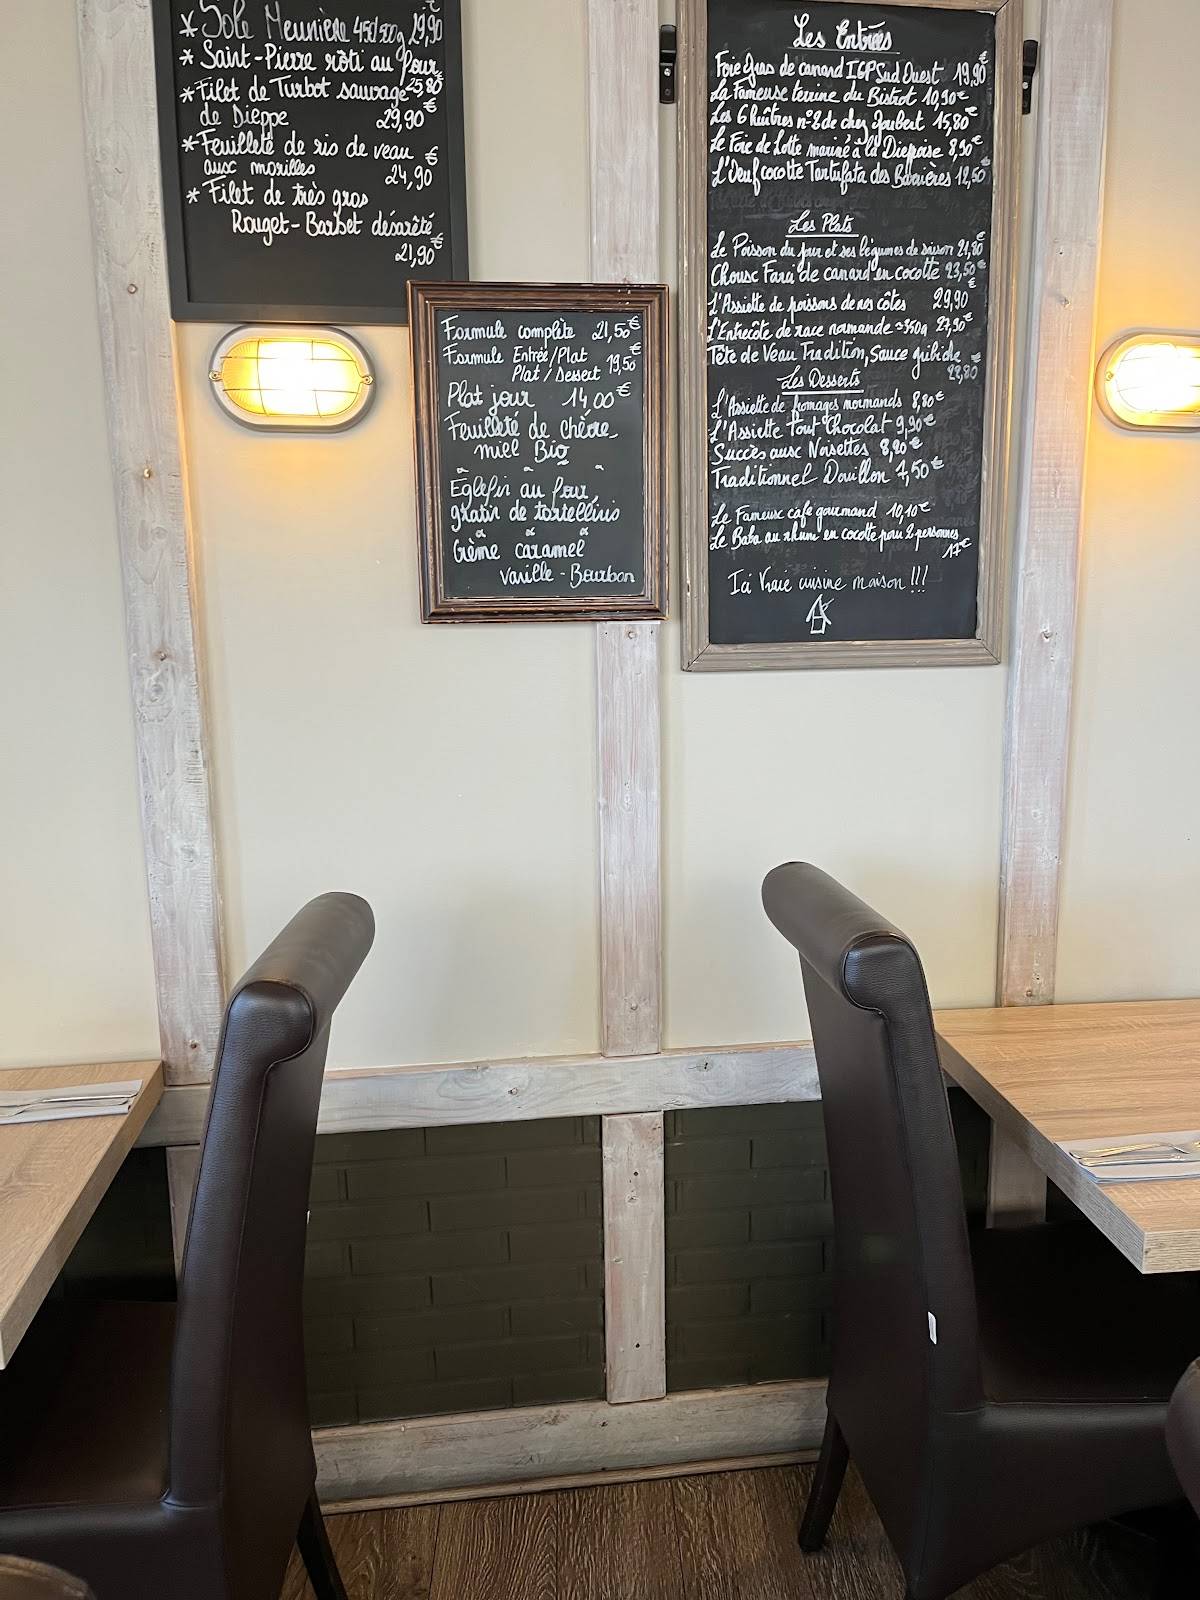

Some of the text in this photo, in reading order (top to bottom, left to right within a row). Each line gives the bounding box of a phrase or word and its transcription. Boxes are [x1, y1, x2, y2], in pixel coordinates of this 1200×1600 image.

[202, 0, 254, 39] Sole
[793, 13, 893, 51] Les Entrées
[325, 49, 364, 72] rôti
[370, 55, 394, 72] au
[400, 50, 440, 86] four
[715, 50, 741, 78] Foie
[780, 53, 796, 77] de
[799, 56, 844, 78] canard
[875, 61, 900, 84] Sud
[902, 61, 944, 85] Ouest
[953, 50, 988, 87] 19,90€
[195, 75, 409, 108] Filet de Turbot sauvage
[710, 75, 969, 111] La Fameuse terrine du Bistrot 10,90€
[200, 99, 437, 139] de Dieppe 29,90€
[710, 101, 732, 126] Les
[737, 103, 749, 124] 6
[821, 109, 838, 130] de
[932, 106, 978, 137] 15,80€
[284, 130, 305, 156] de
[313, 134, 338, 156] ris
[346, 134, 368, 158] de
[374, 143, 414, 160] veau
[710, 125, 727, 153] Le
[729, 131, 753, 154] Foie
[755, 132, 772, 154] de
[773, 129, 802, 156] Lotte
[806, 133, 851, 158] mariné
[865, 135, 878, 157] la
[251, 159, 315, 176] morilles
[385, 146, 438, 190] 24,90€
[760, 158, 804, 180] cocotte
[870, 162, 890, 184] des
[202, 175, 369, 214] Filet de très gros
[788, 209, 854, 234] Les Plats
[395, 233, 444, 268] 21,90€
[710, 230, 954, 273] Le Poisson du jour et ses légumes de saison
[799, 262, 820, 282] de
[824, 260, 871, 281] canard
[873, 267, 894, 281] en
[894, 256, 940, 280] cocotte
[769, 295, 784, 310] de
[787, 293, 837, 324] poissons
[841, 292, 855, 311] de
[856, 298, 874, 311] nos
[877, 288, 906, 311] côtes
[933, 277, 976, 312] 29,90€
[441, 315, 641, 348] Formule complète 21,50€
[775, 319, 792, 339] de
[794, 324, 824, 338] race
[828, 316, 893, 335] normande
[443, 342, 641, 376] Formule 19,50€
[706, 344, 738, 366] Tête
[740, 344, 760, 363] de
[763, 342, 798, 362] Veau
[776, 364, 861, 390] Les Desserts
[448, 380, 535, 416] Plat jour
[771, 394, 785, 413] de
[792, 394, 839, 424] fromages
[843, 388, 902, 410] normands
[444, 411, 550, 441] Feuilleté de
[708, 418, 784, 443] L'Assiette
[825, 411, 893, 435] Chocolat
[896, 413, 936, 440] 9,90€
[474, 439, 570, 463] miel Bio
[711, 437, 869, 465] Succès aux Noisettes
[711, 458, 891, 489] Traditionnel Douillon
[520, 482, 545, 499] au
[451, 501, 500, 532] gratin
[509, 499, 527, 522] de
[711, 503, 732, 527] Le
[816, 500, 877, 532] gourmand
[886, 501, 931, 525] 10,10€
[710, 524, 728, 550] Le
[731, 525, 762, 550] Baba
[765, 531, 780, 542] au
[823, 528, 839, 540] en
[841, 522, 877, 541] cocotte
[876, 529, 903, 552] pour
[904, 523, 915, 539] 2
[914, 526, 959, 551] personnes
[941, 537, 972, 559] 17€
[570, 563, 636, 589] Bourbon
[728, 568, 752, 595] Ici
[759, 566, 793, 593] Vraie
[799, 566, 848, 591] cuisine
[852, 572, 906, 590] maison
